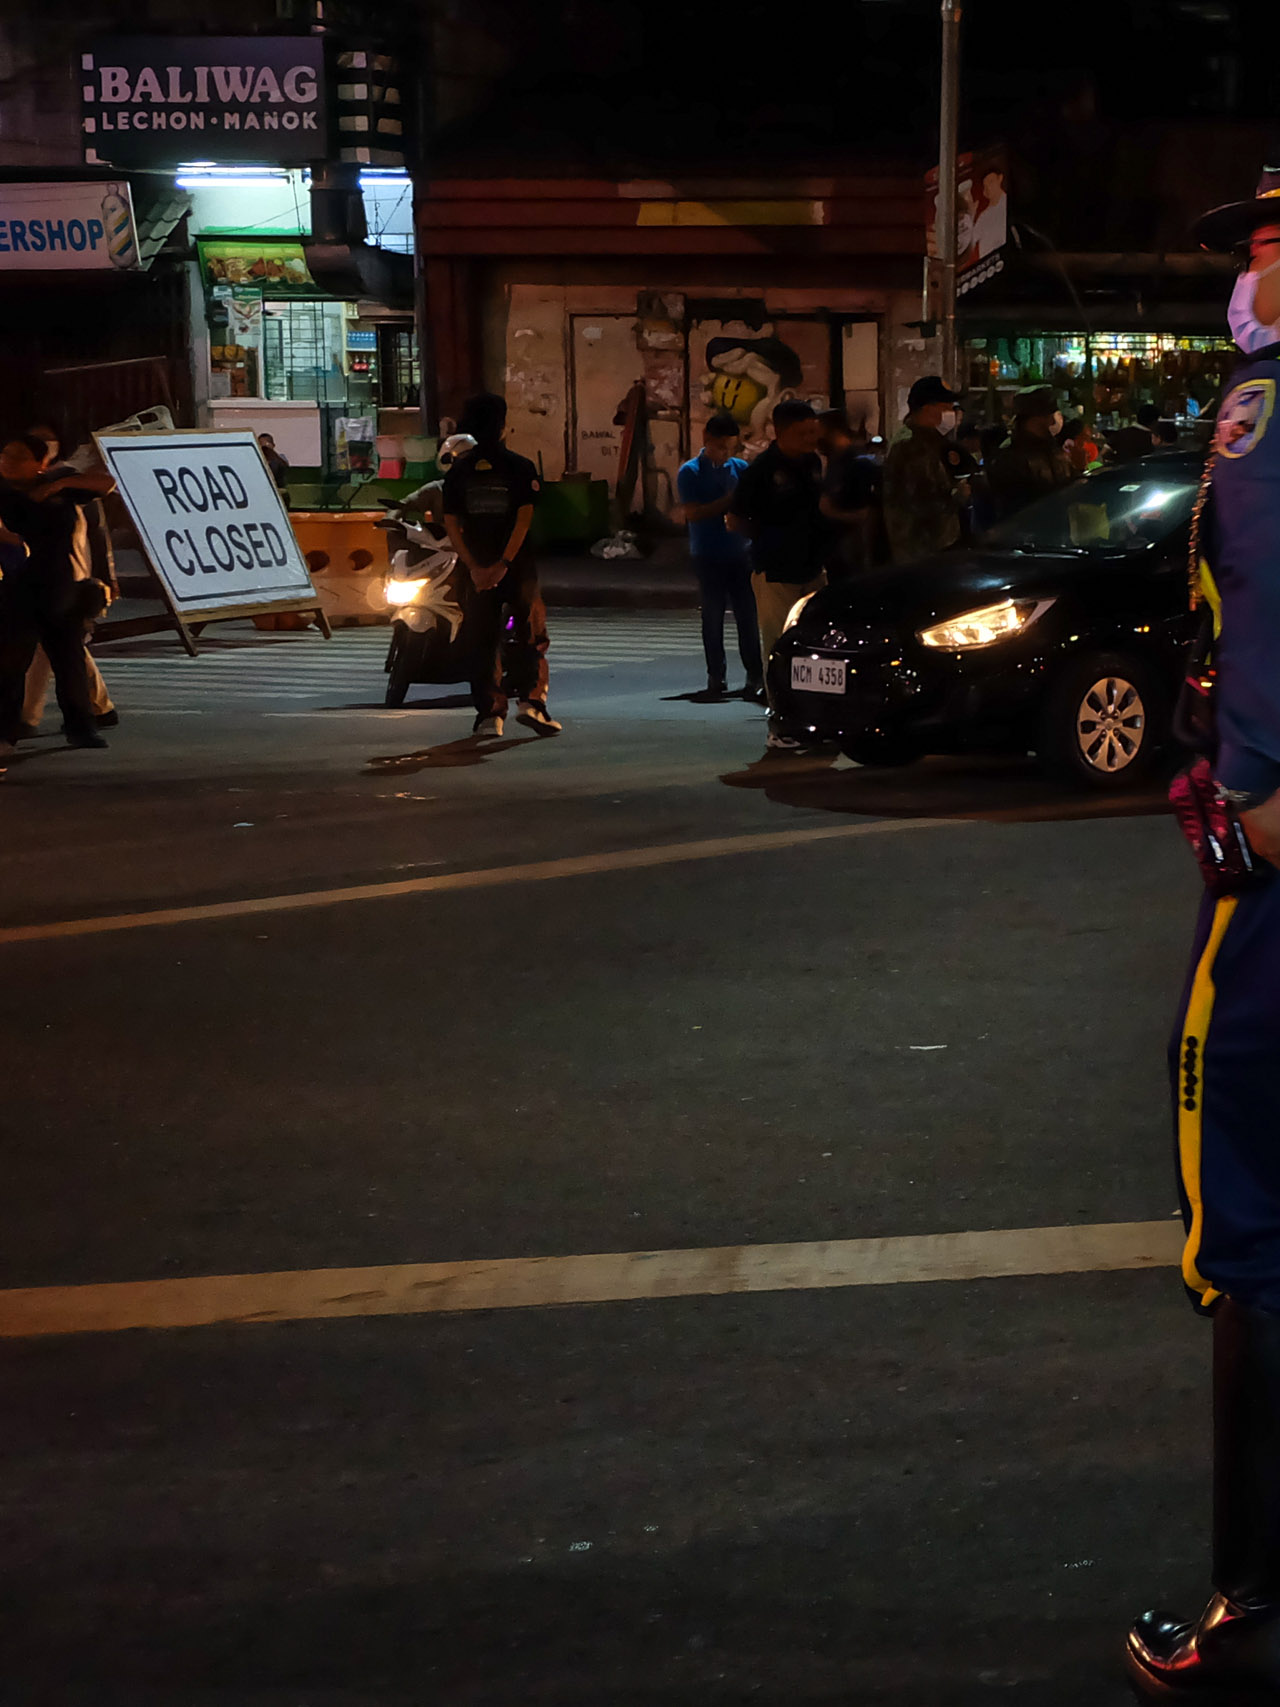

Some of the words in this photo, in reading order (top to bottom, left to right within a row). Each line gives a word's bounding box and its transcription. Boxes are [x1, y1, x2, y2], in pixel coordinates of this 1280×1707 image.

[99, 66, 318, 103] BALIWAG
[103, 112, 205, 130] LECHON
[224, 112, 318, 130] MANOK
[0, 219, 104, 252] ERSHOP
[152, 465, 249, 514] ROAD
[165, 522, 288, 576] CLOSED
[819, 667, 843, 686] 4358
